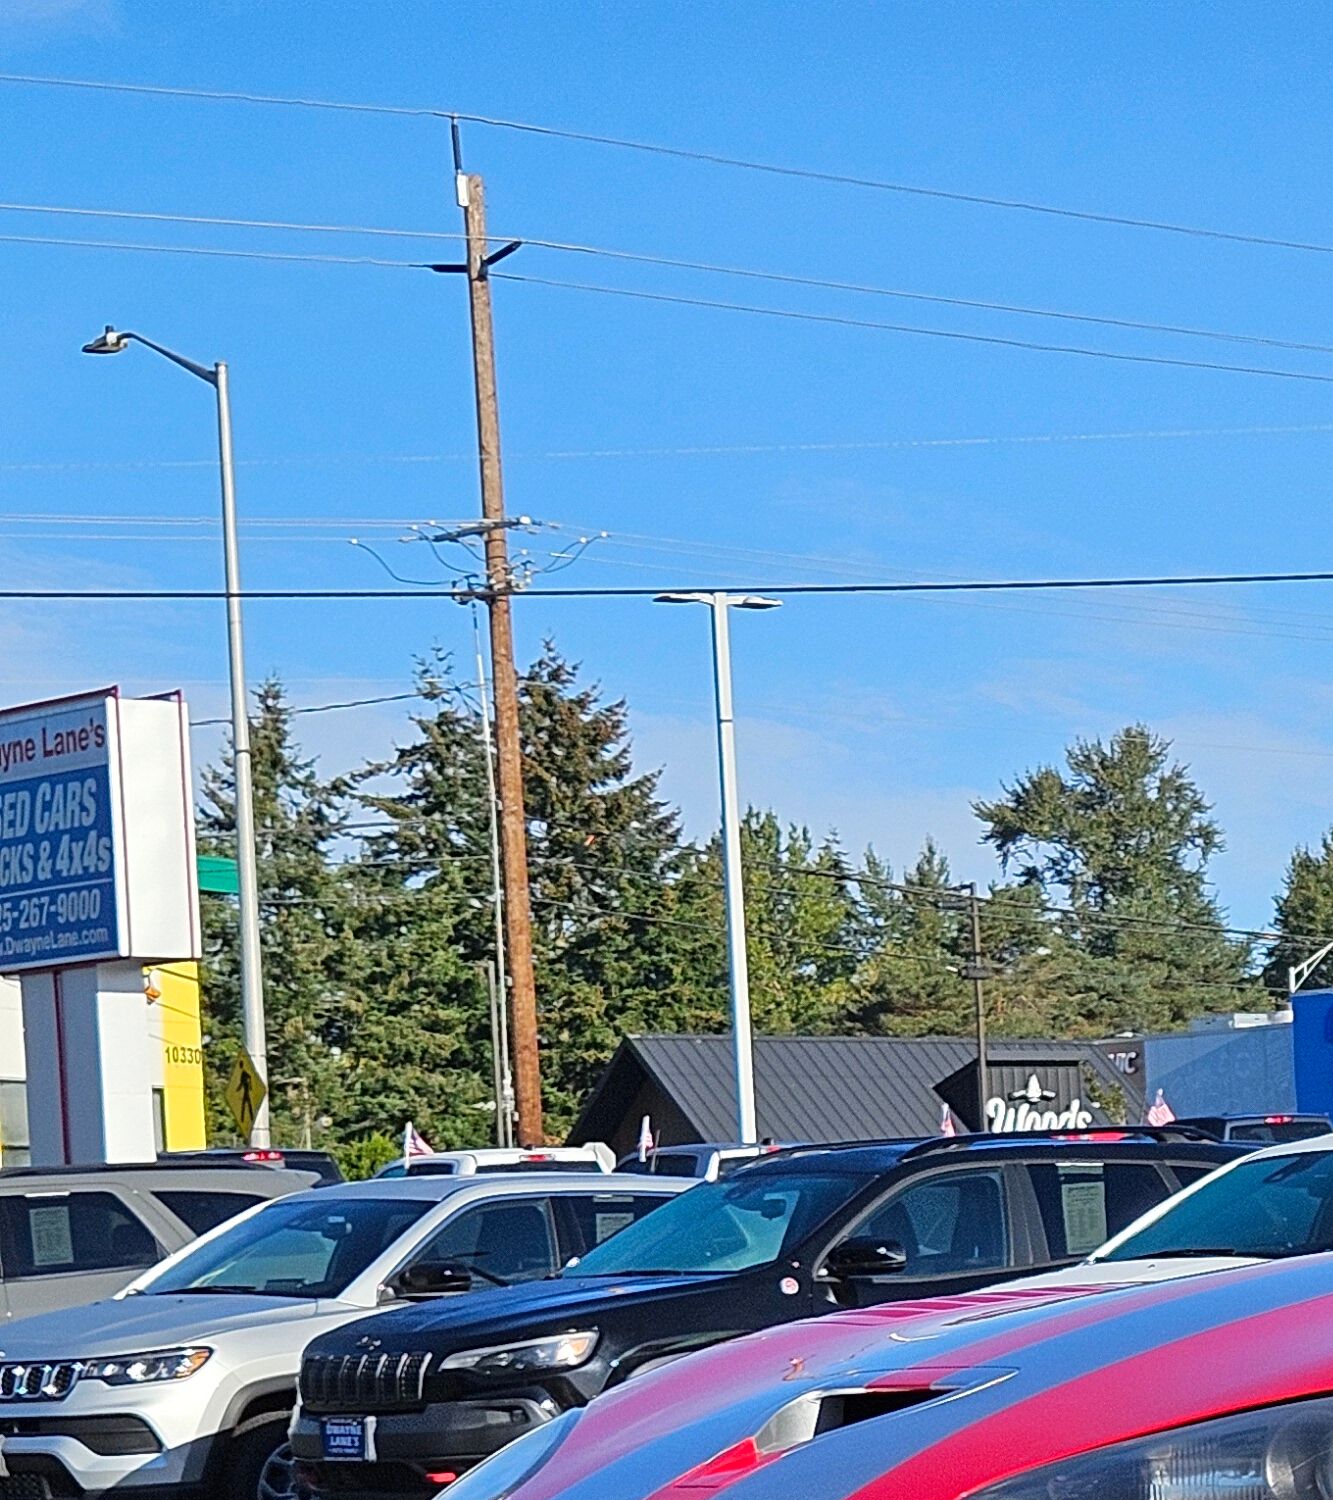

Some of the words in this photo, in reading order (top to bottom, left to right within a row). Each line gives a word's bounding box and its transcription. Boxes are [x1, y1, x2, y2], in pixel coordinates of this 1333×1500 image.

[42, 717, 105, 758] Lane's
[0, 790, 31, 840] ED
[34, 777, 97, 835] CARS
[37, 840, 53, 881] &
[56, 829, 111, 877] 4x4s
[0, 888, 101, 932] 5-267-9000
[165, 1046, 201, 1065] 10330
